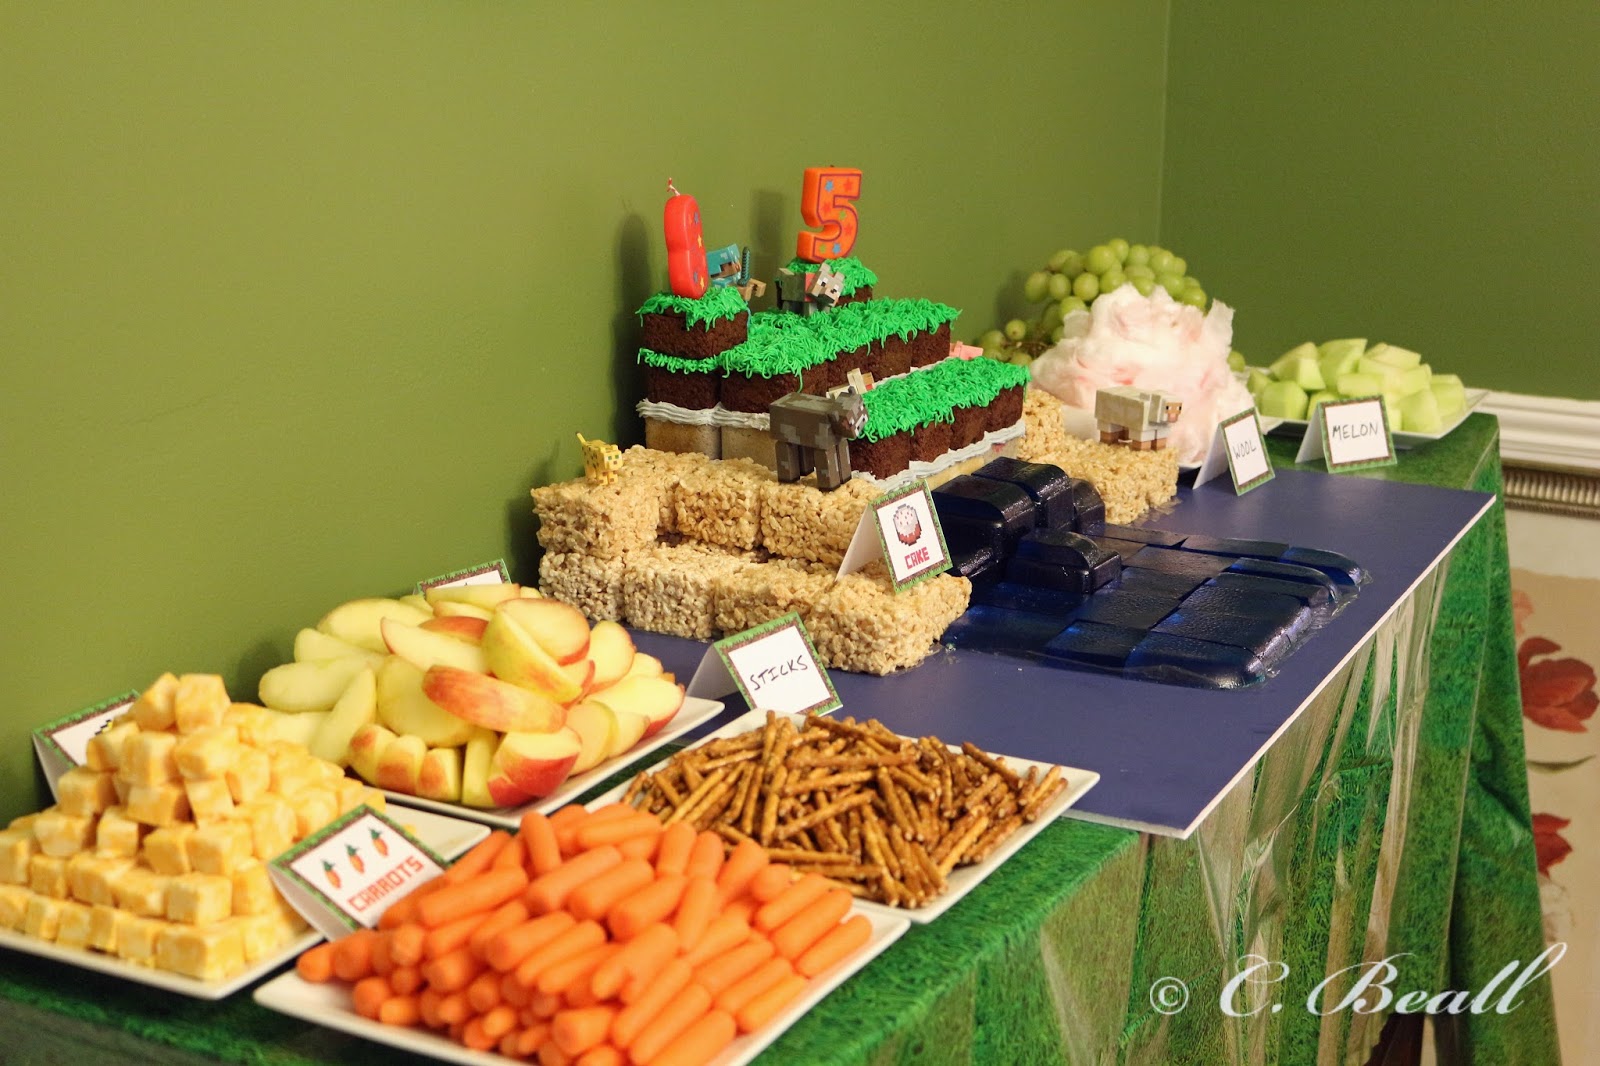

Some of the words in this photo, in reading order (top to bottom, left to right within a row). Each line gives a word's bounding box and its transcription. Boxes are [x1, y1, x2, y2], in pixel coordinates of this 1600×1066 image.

[796, 165, 863, 264] 5
[1331, 422, 1380, 441] MELON
[1232, 439, 1257, 460] WOOL
[904, 546, 930, 570] CAKE
[749, 654, 808, 691] STICKS
[347, 855, 425, 912] CARROTS
